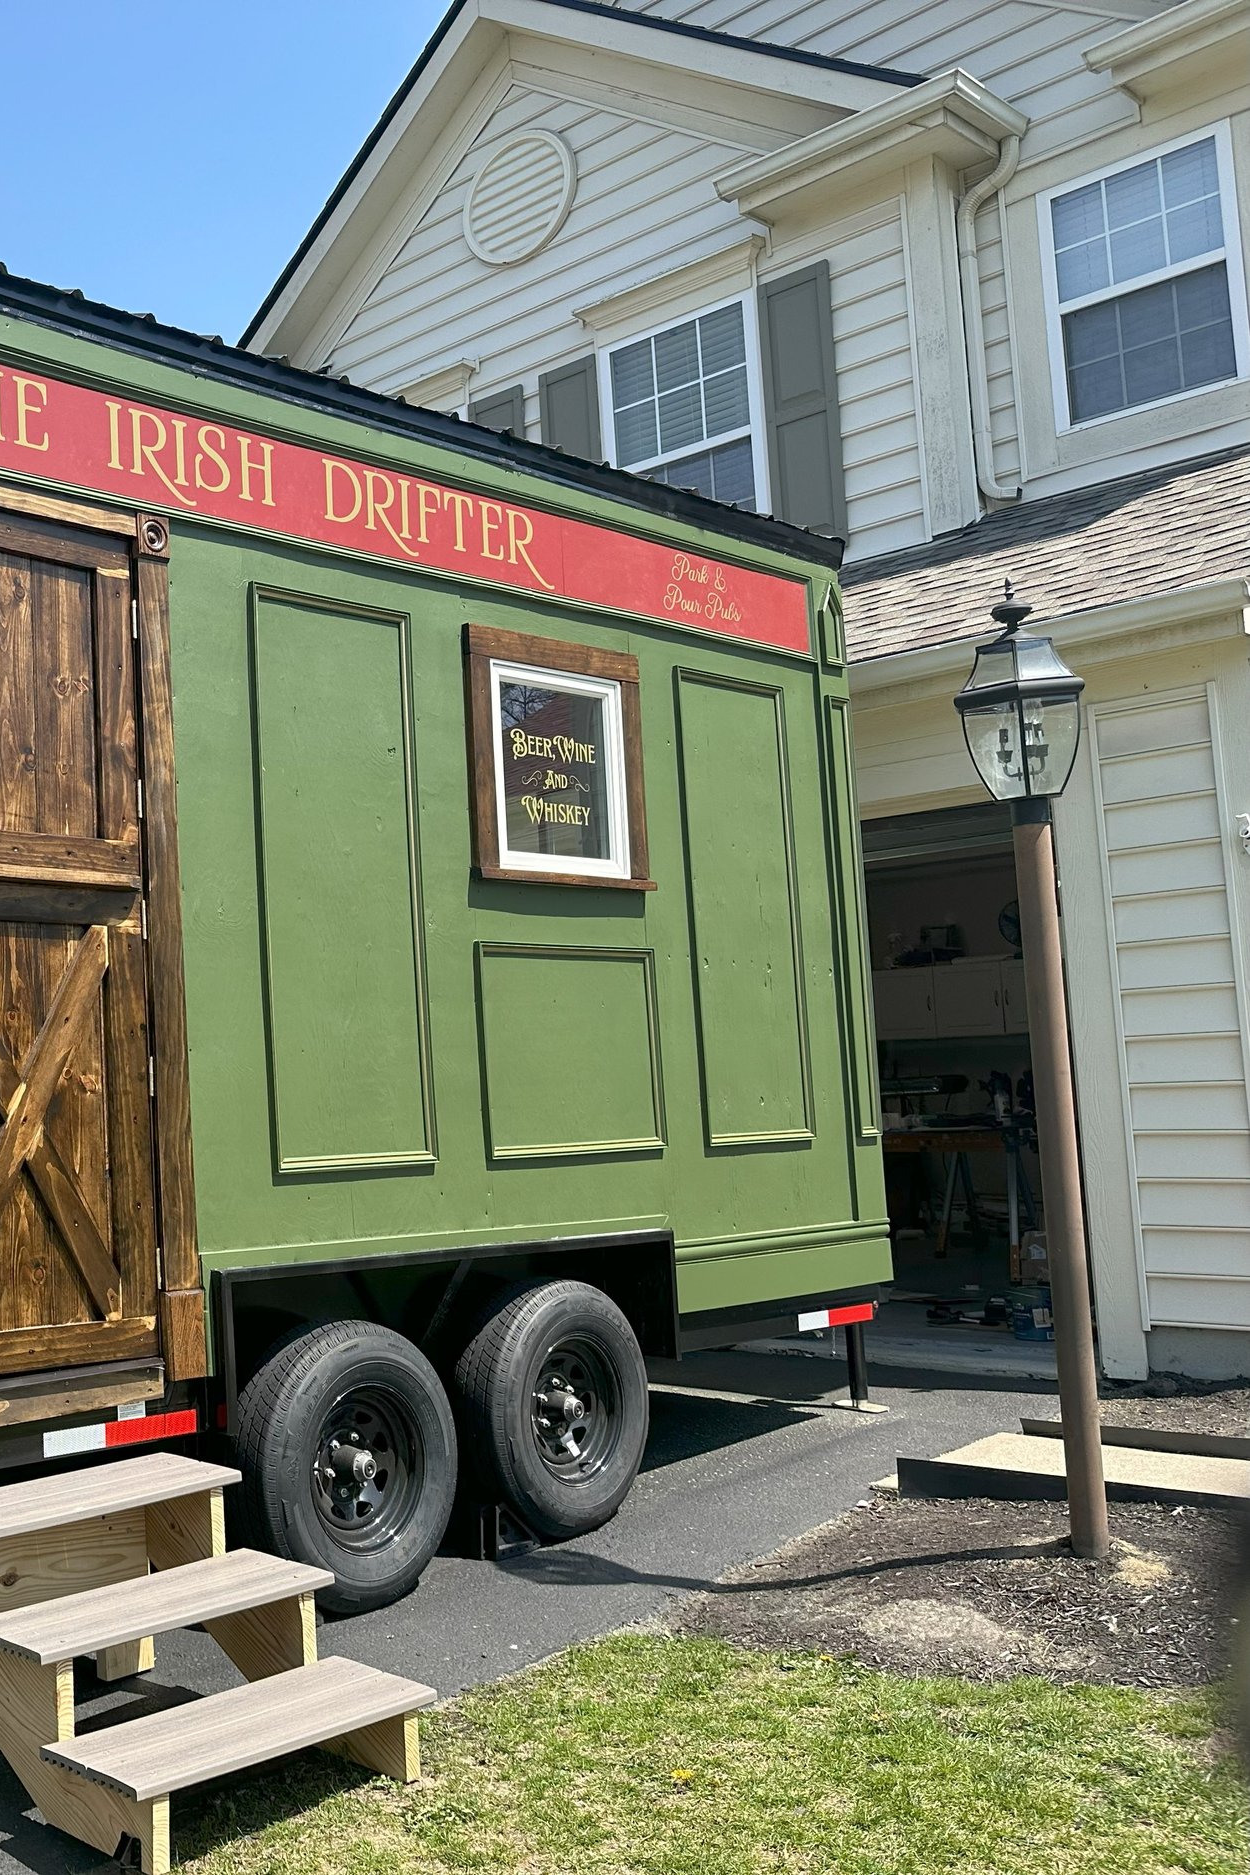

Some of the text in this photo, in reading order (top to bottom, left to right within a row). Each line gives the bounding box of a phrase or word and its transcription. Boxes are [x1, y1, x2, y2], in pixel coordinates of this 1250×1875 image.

[105, 400, 276, 507] IRISH
[321, 457, 555, 590] DRIFTER
[671, 553, 728, 594] Park &
[663, 583, 742, 622] Pour Pubs
